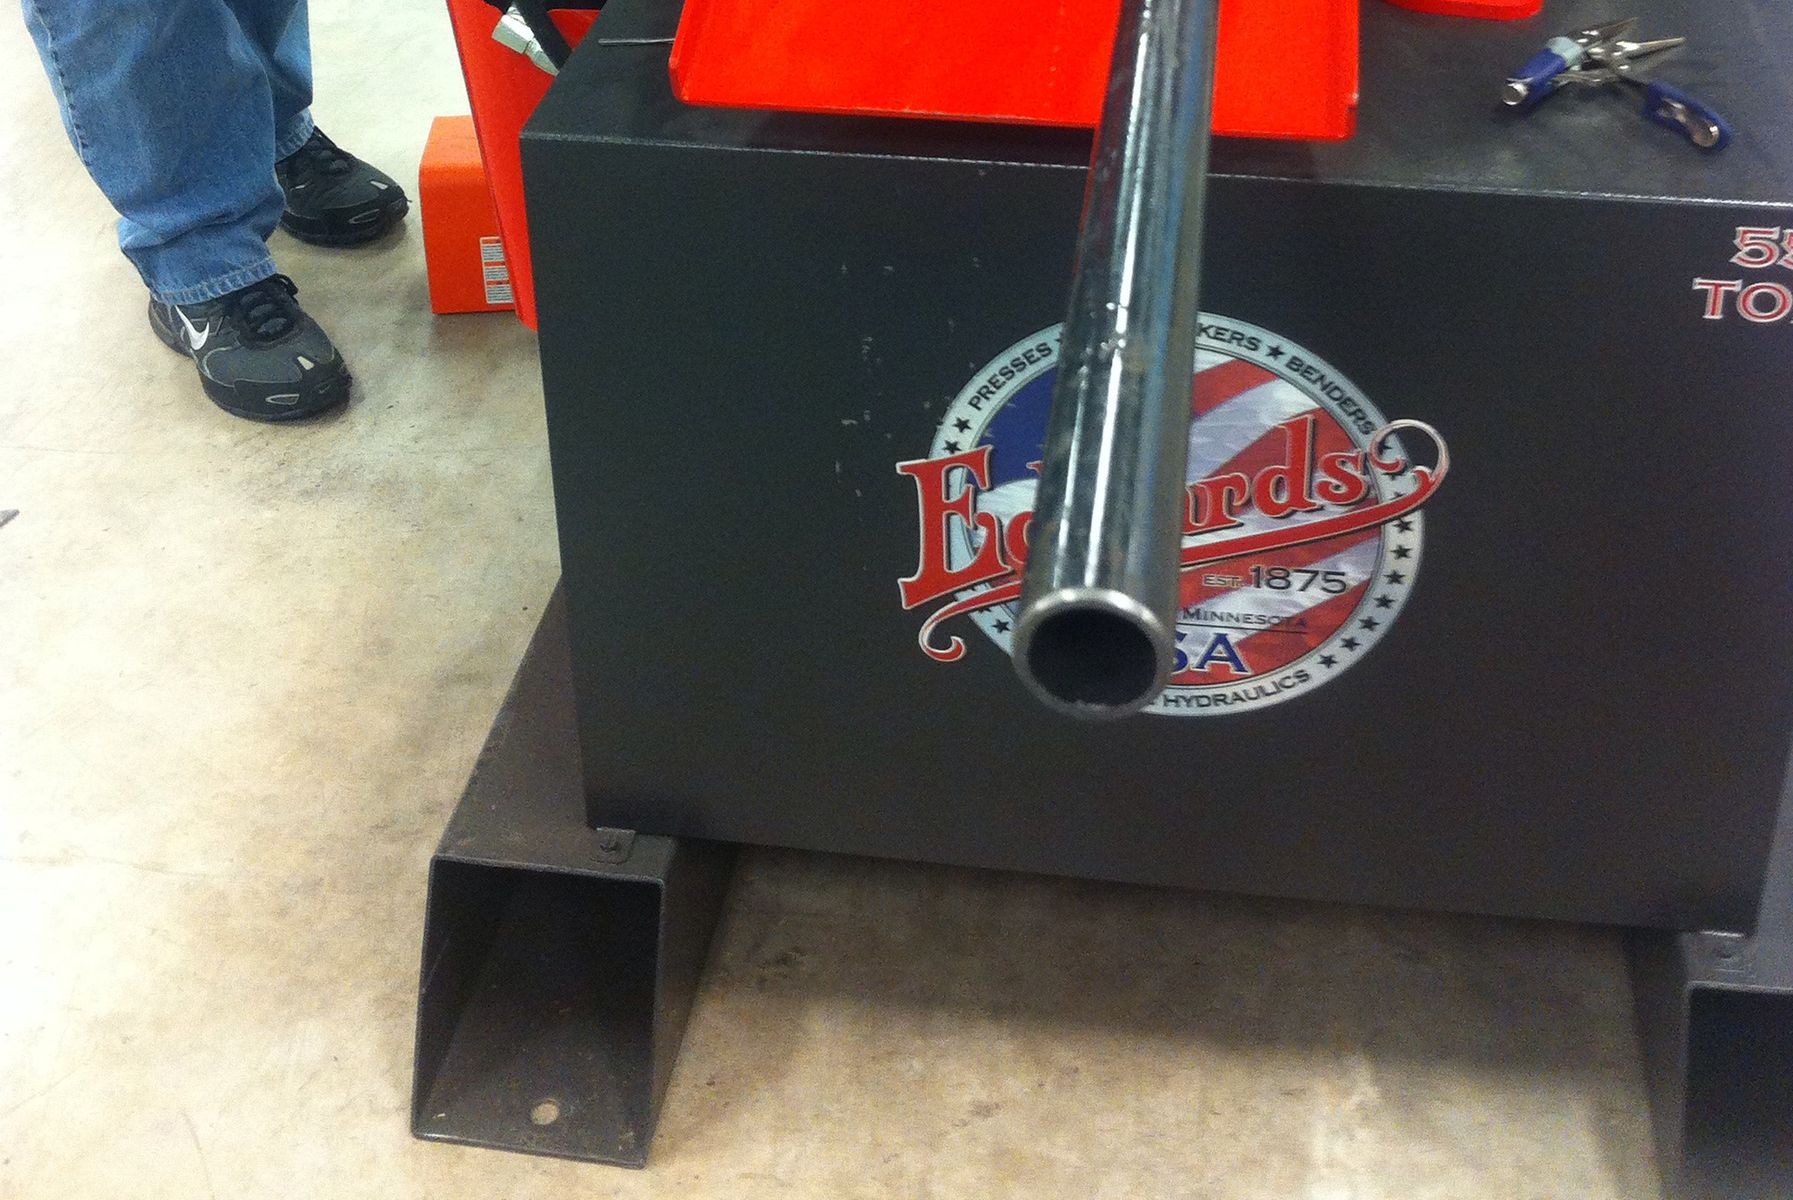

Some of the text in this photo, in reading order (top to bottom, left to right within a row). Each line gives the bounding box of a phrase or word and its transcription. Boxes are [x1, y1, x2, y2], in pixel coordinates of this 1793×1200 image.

[1692, 277, 1793, 324] TO
[967, 341, 1053, 412] PRESSES
[1199, 323, 1377, 436] KERS BENDERS
[1250, 565, 1347, 594] 1875
[1163, 669, 1310, 708] HYDRAULICS
